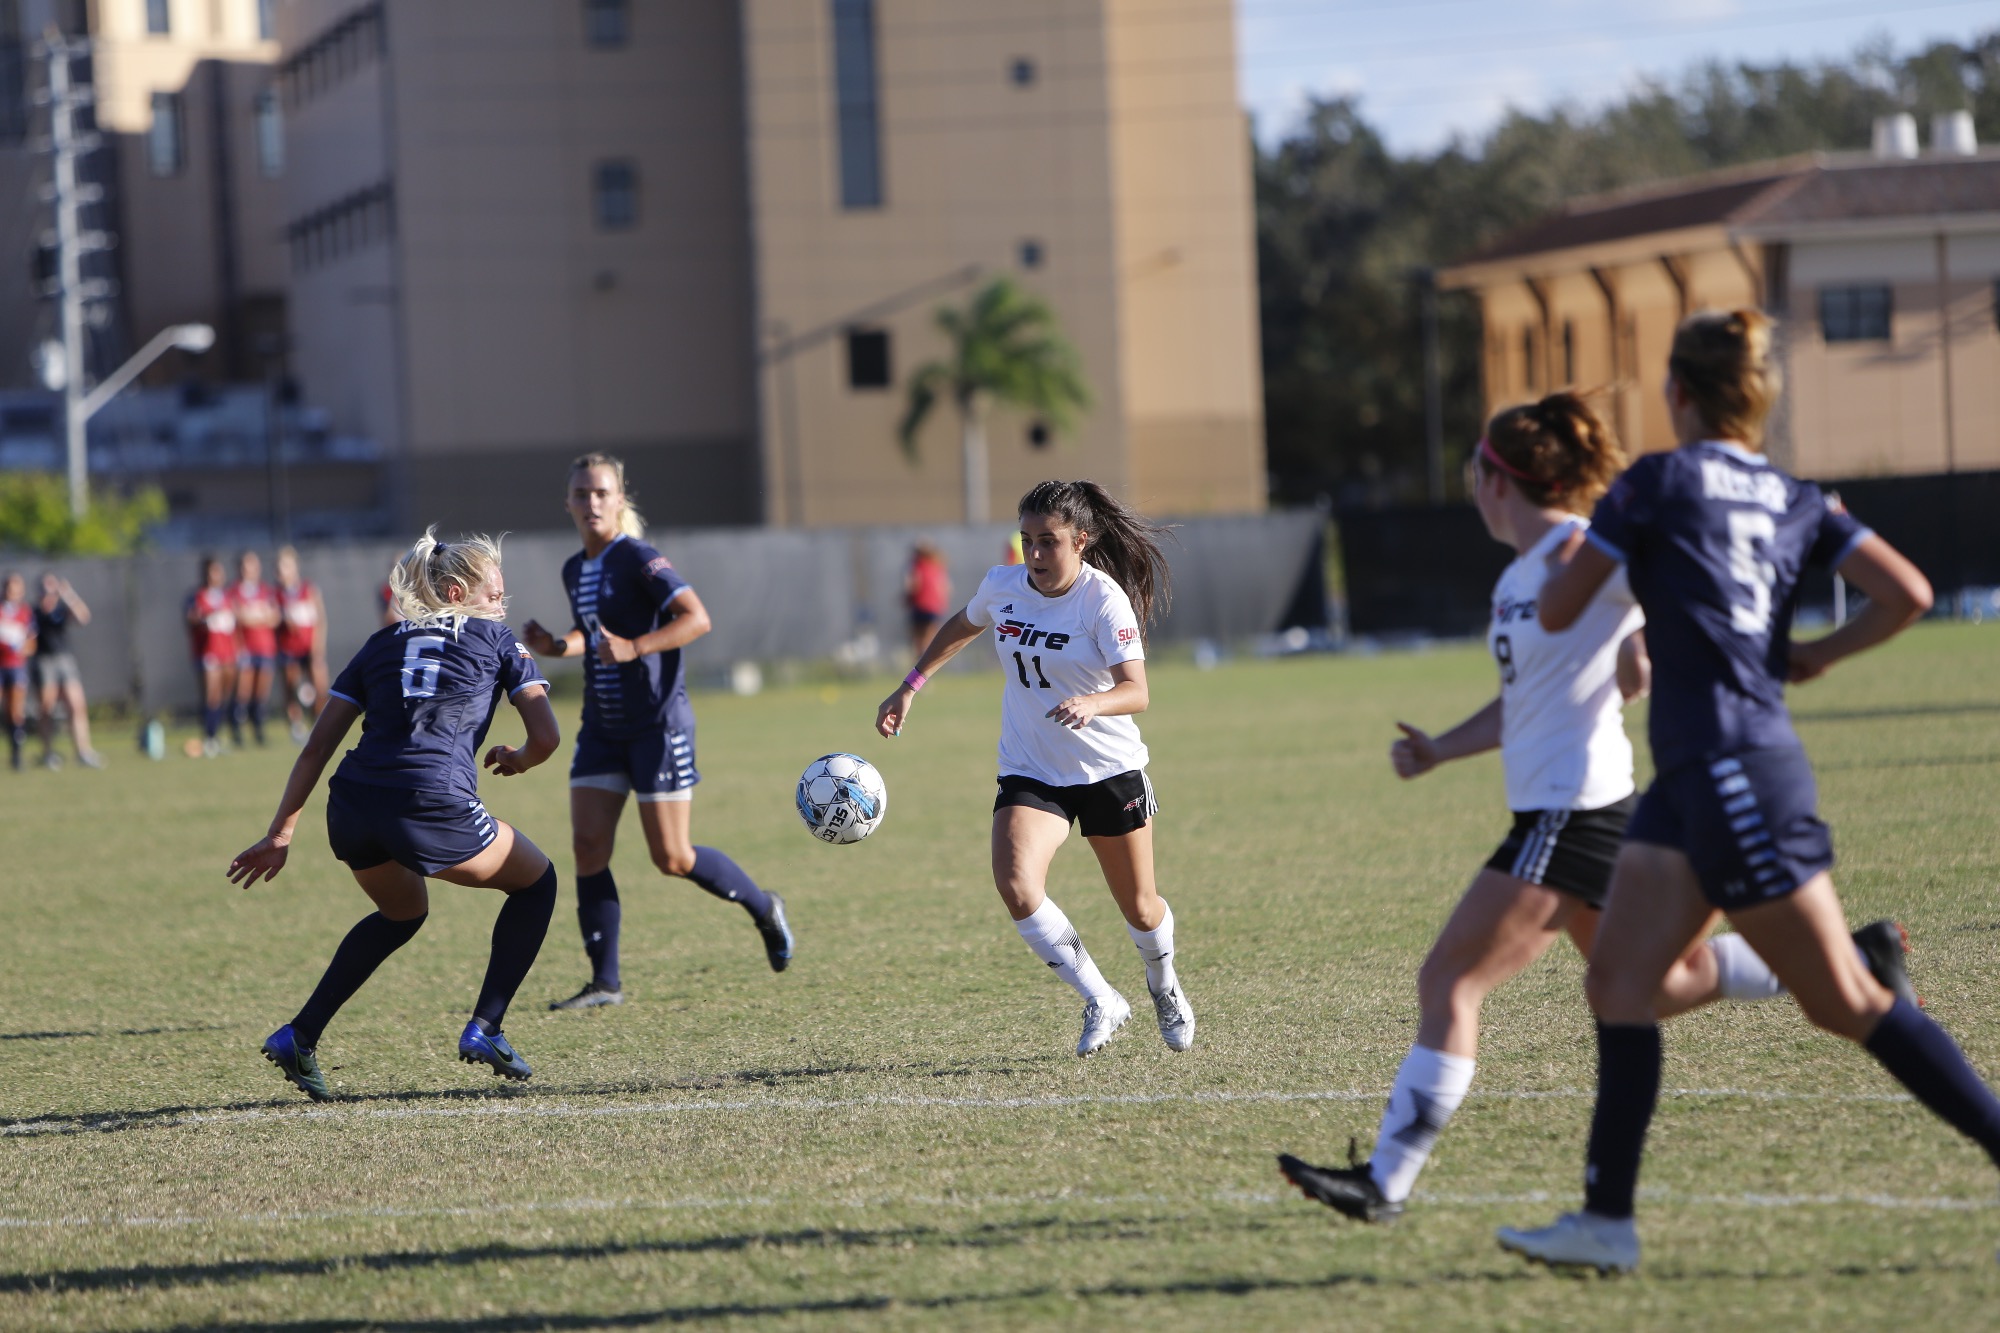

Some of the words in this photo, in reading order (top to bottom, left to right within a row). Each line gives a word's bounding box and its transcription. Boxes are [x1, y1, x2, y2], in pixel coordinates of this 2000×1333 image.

[1727, 510, 1777, 635] 5
[996, 619, 1070, 650] Fire
[400, 635, 446, 698] 6
[1012, 650, 1052, 689] 11
